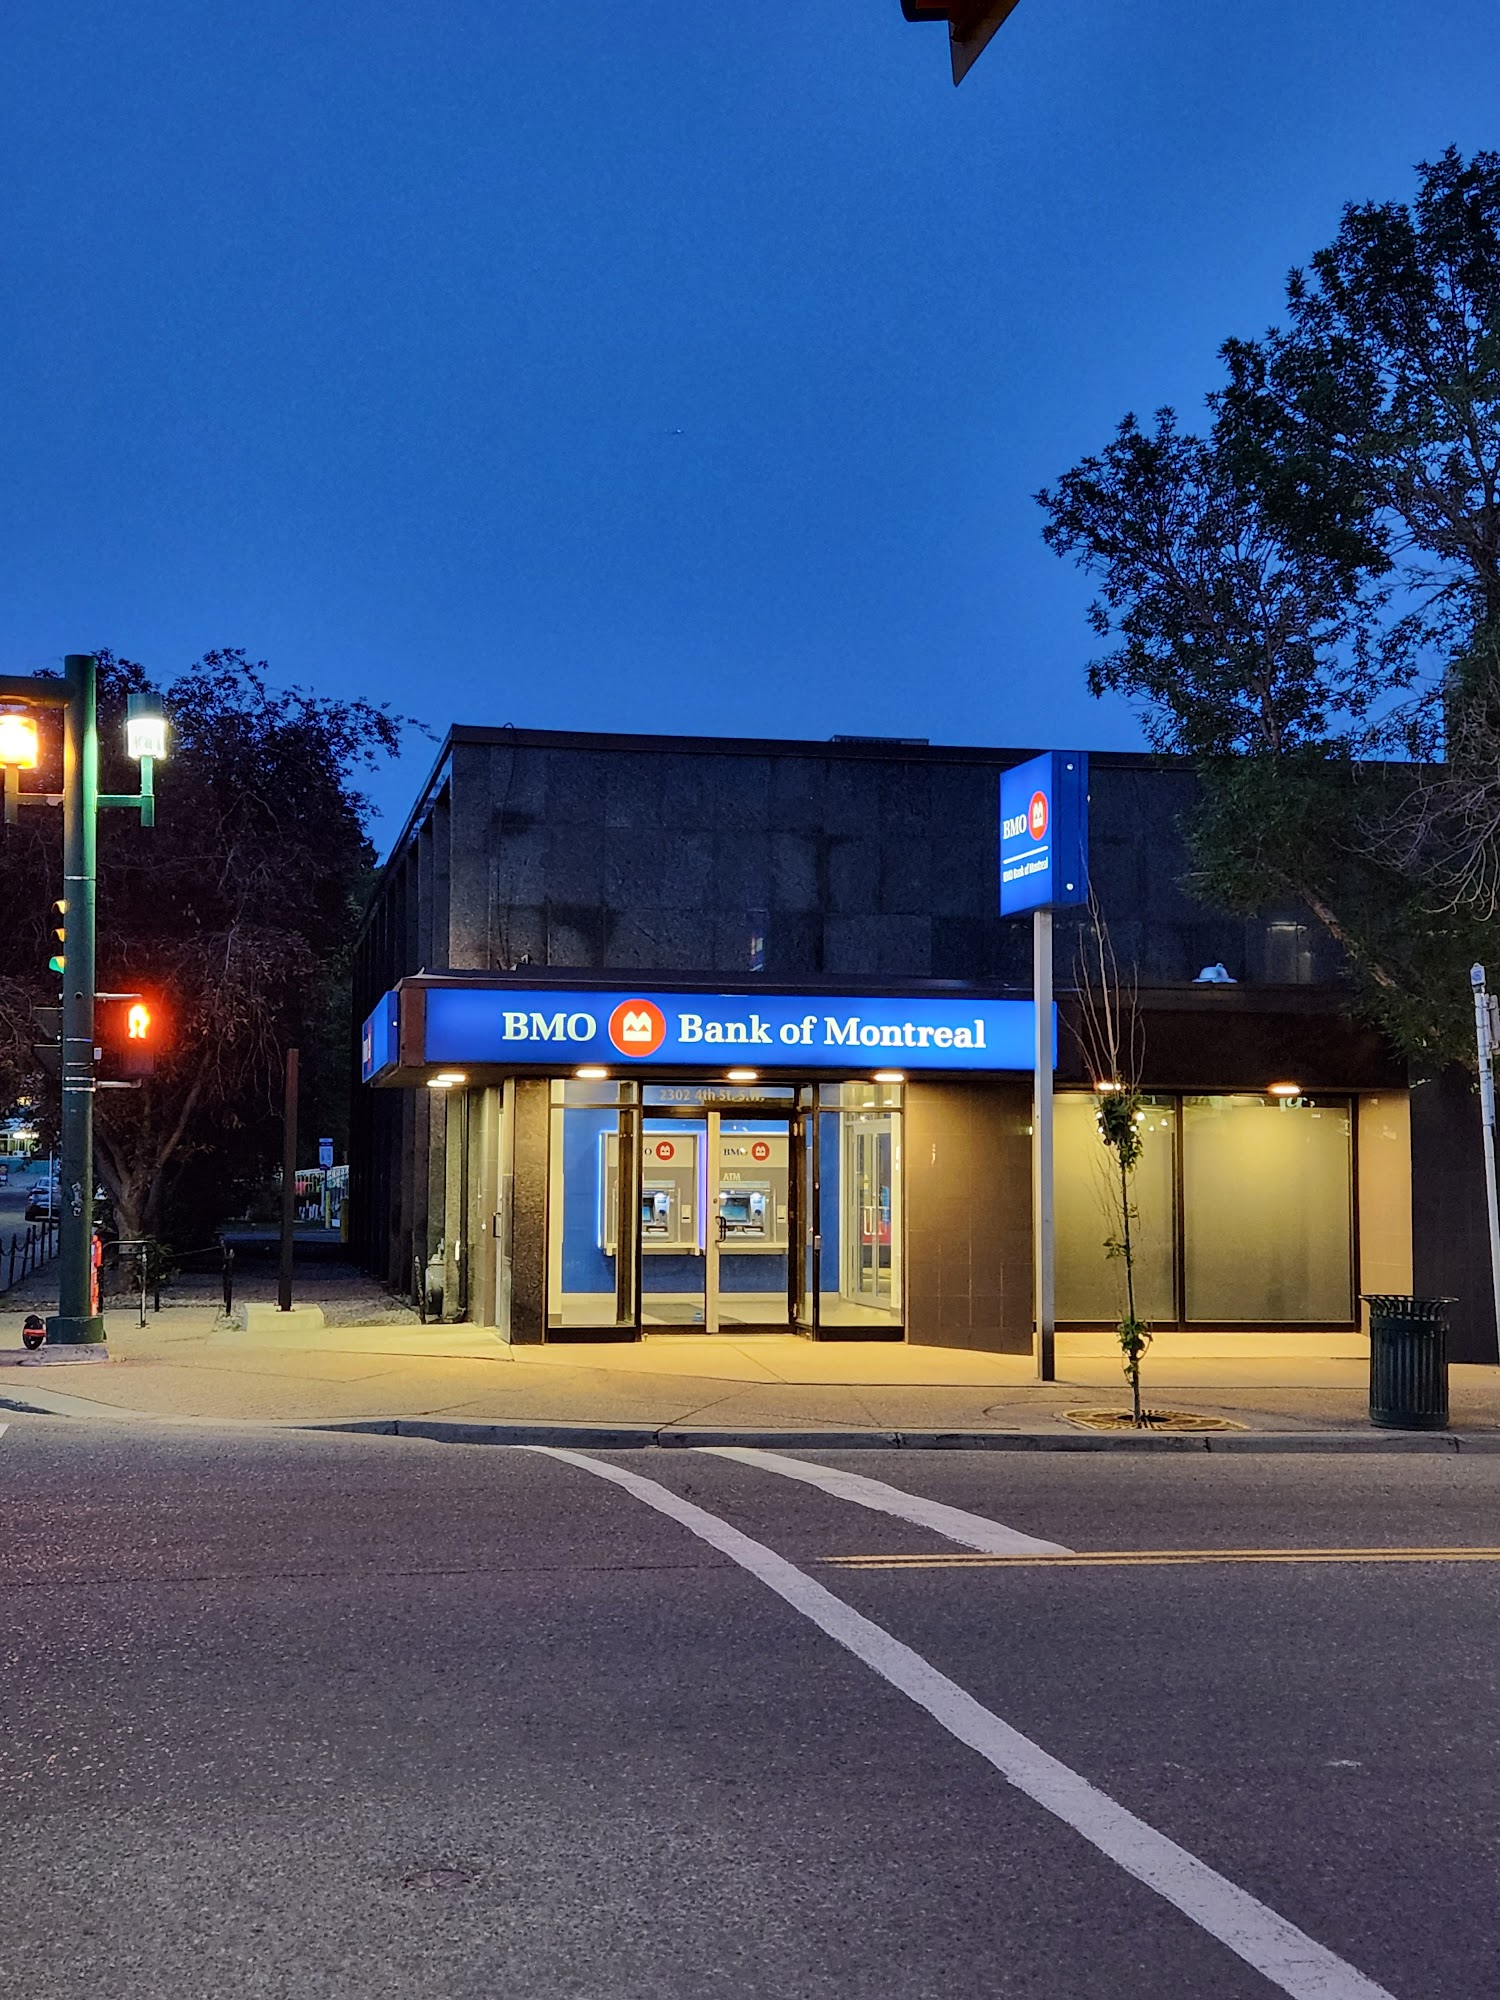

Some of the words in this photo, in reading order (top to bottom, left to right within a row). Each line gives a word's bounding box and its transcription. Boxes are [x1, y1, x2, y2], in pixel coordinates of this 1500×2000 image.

[1003, 814, 1027, 839] BMO
[502, 1012, 597, 1041] BMO
[678, 1014, 773, 1044] Bank
[779, 1015, 818, 1044] of
[824, 1017, 986, 1048] Montreal
[660, 1089, 691, 1101] 2302
[695, 1088, 716, 1102] 4th
[722, 1172, 741, 1181] ATM
